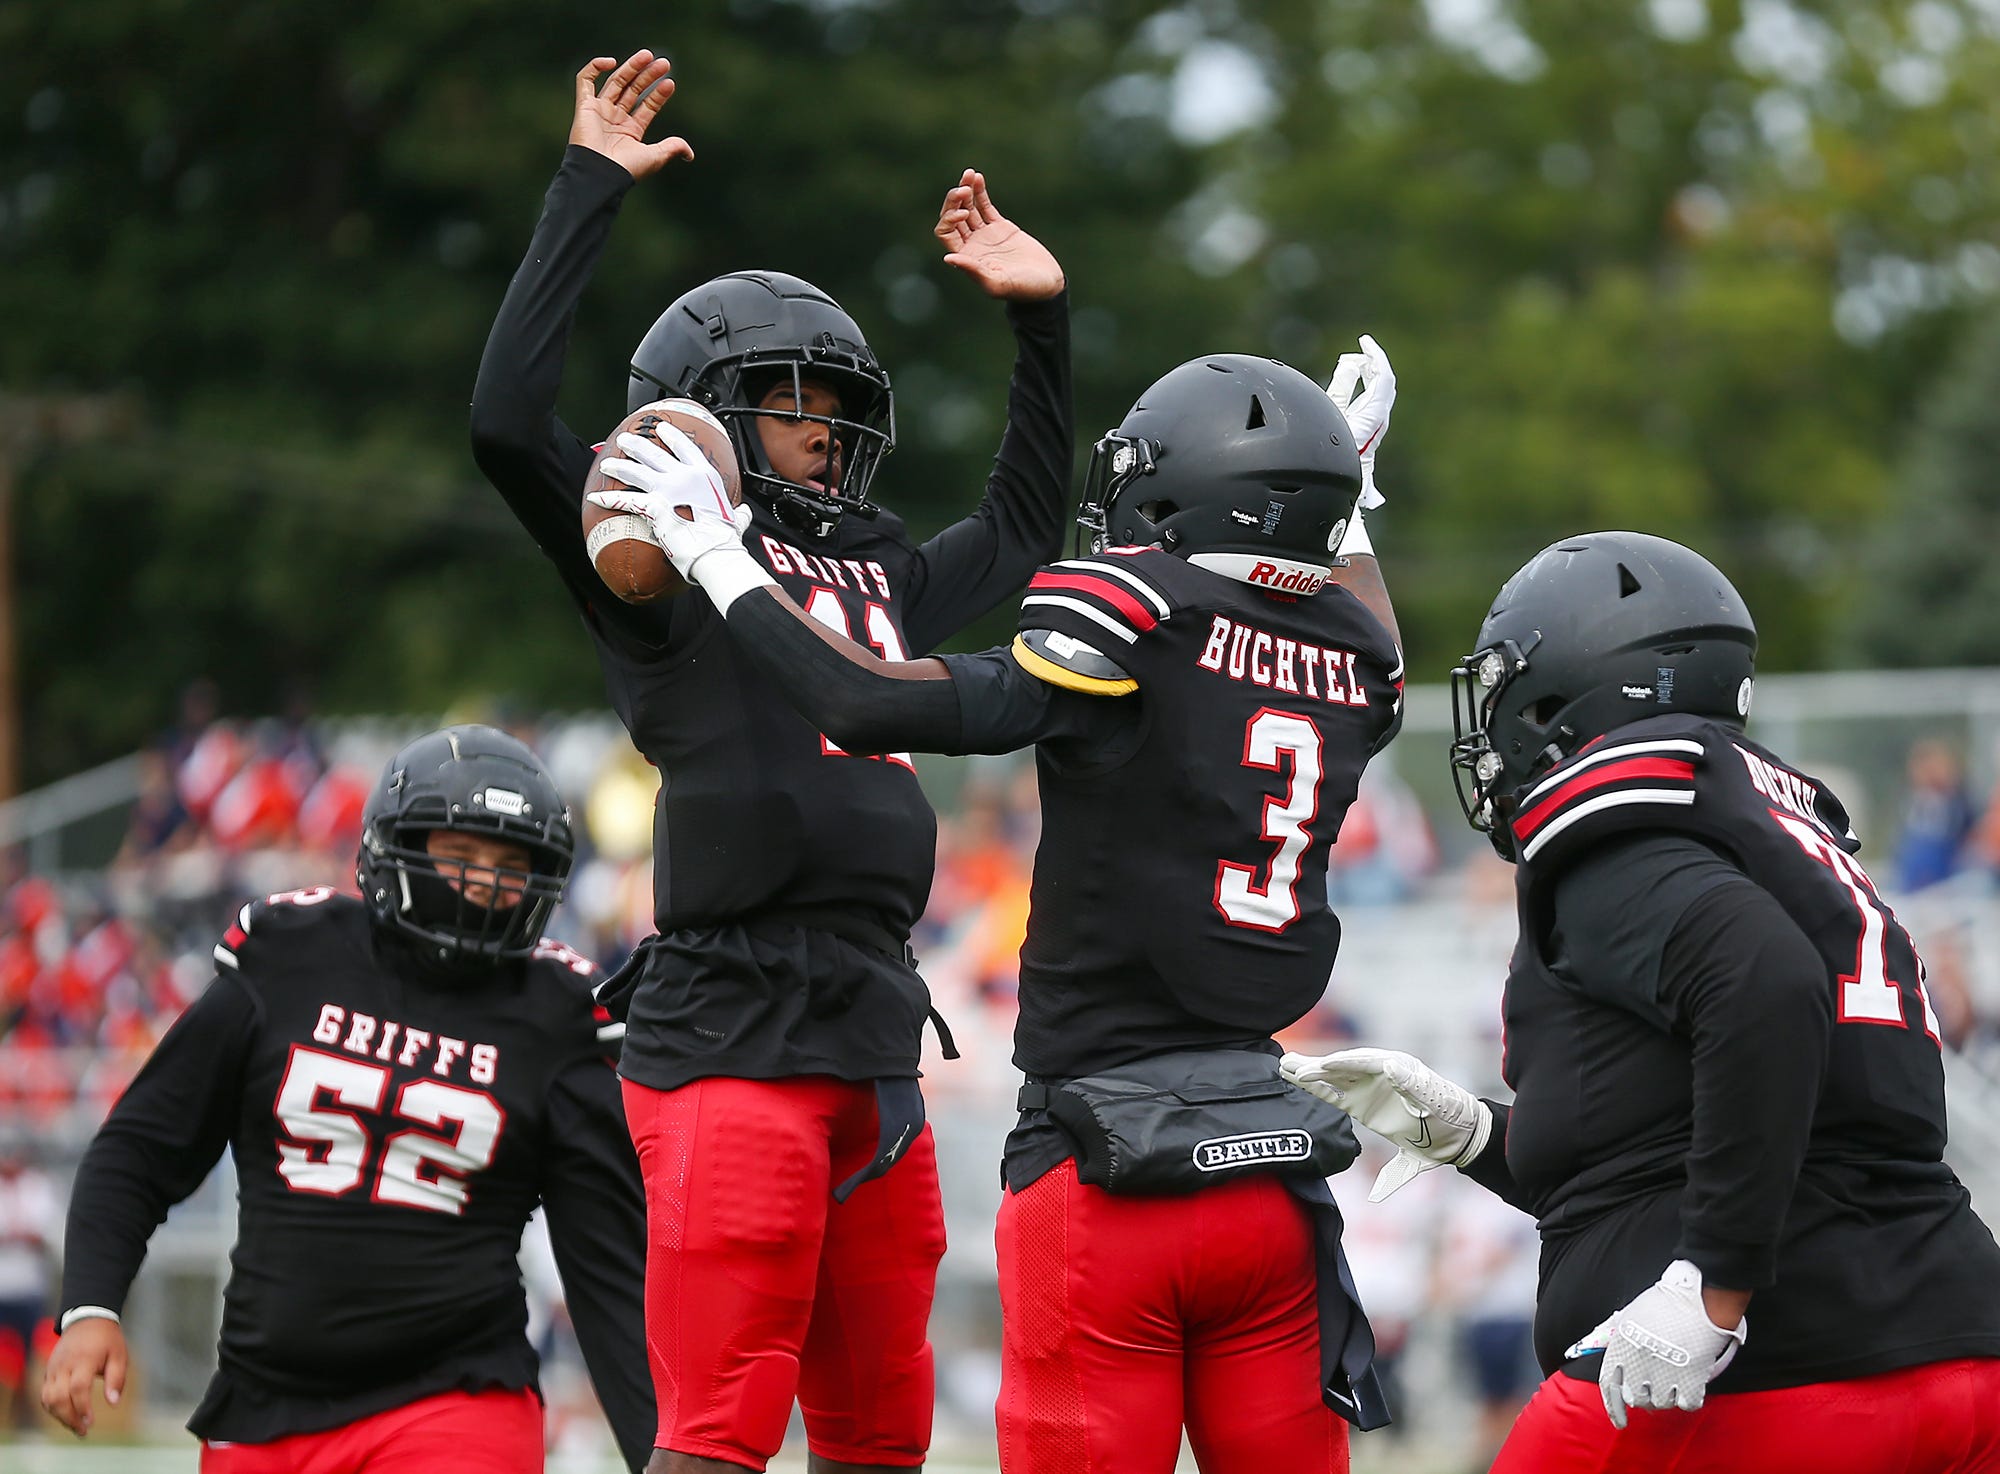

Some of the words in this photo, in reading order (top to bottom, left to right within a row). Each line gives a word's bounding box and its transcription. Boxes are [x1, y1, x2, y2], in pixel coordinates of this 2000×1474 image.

[760, 534, 891, 601] GRIFFS
[1197, 613, 1370, 707] BUCHTEL
[1211, 706, 1324, 935] 3
[312, 1002, 498, 1085] GRIFFS
[273, 1041, 507, 1216] 52
[1203, 1133, 1306, 1166] BATTLE
